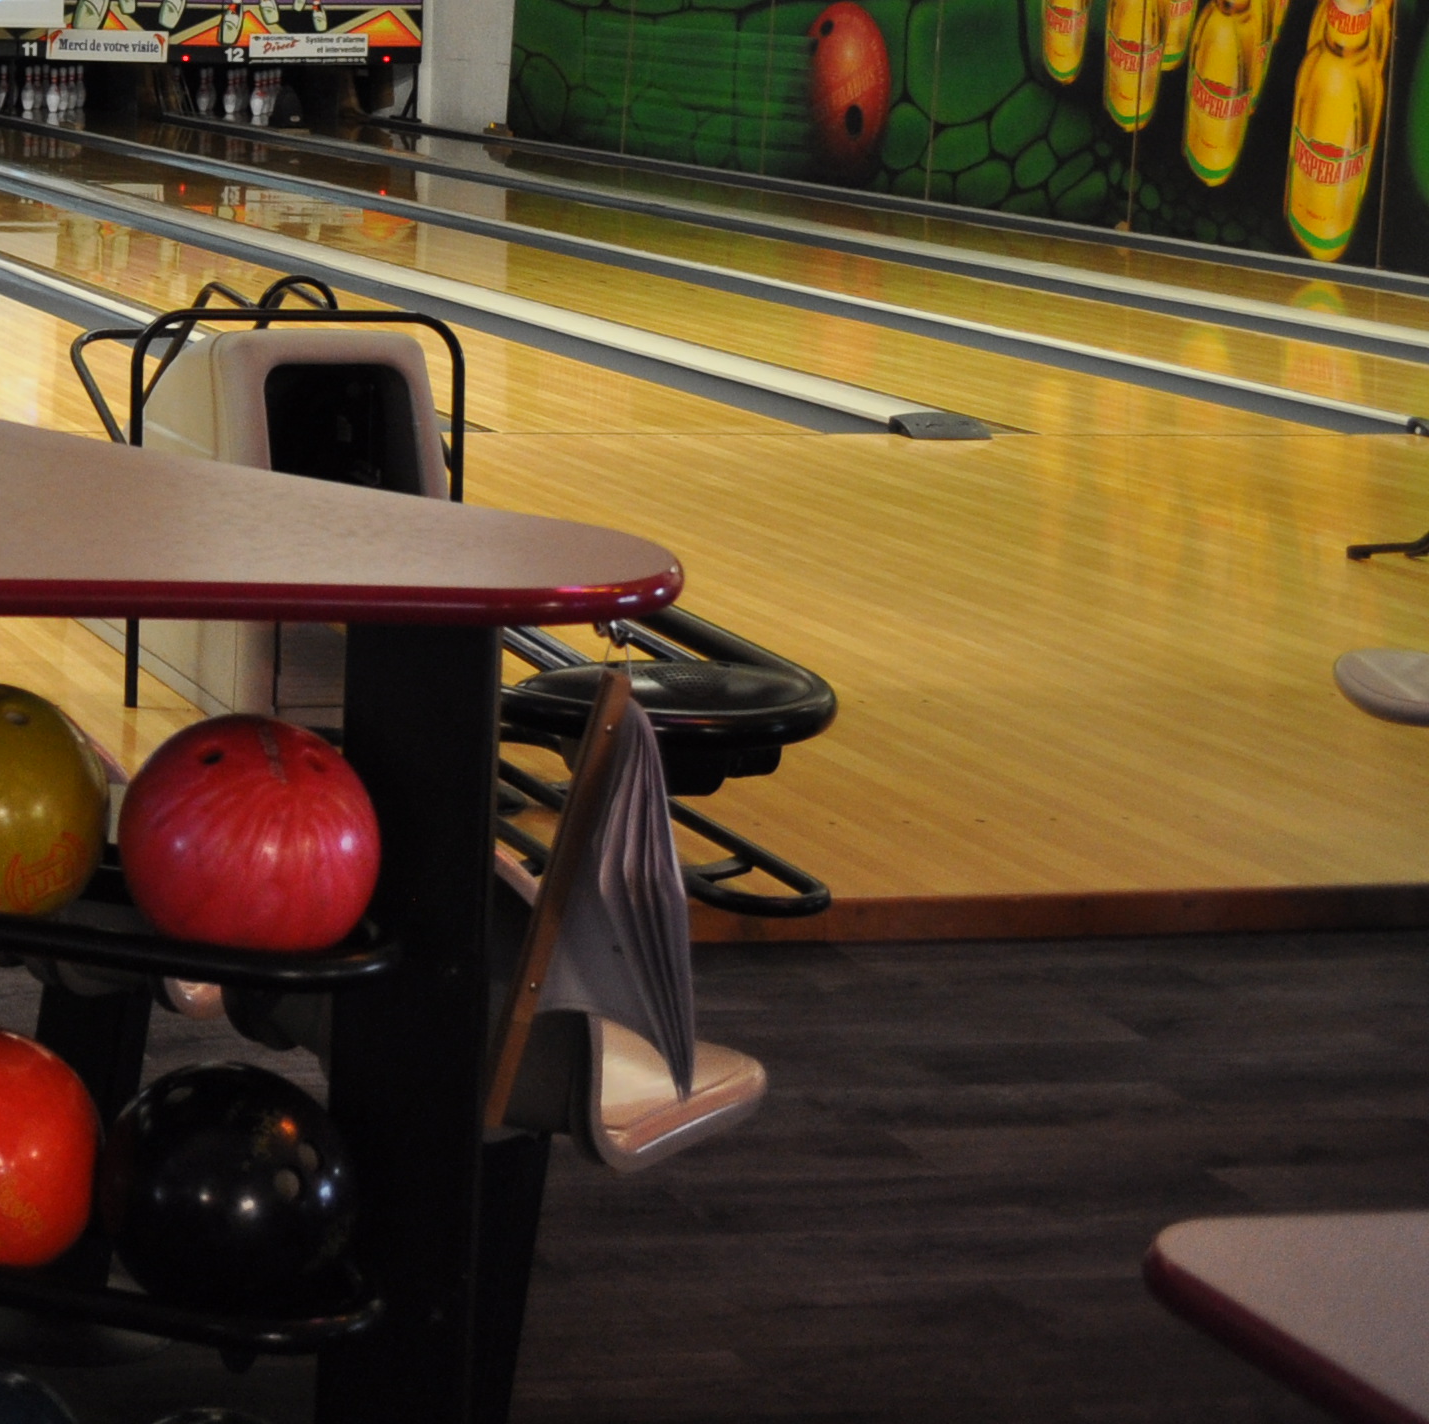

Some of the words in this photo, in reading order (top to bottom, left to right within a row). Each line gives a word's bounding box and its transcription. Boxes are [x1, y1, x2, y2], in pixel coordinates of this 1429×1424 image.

[22, 41, 38, 56] 11
[58, 38, 88, 51] Merci
[103, 41, 129, 52] votre
[131, 41, 159, 53] visite
[224, 47, 244, 62] 12
